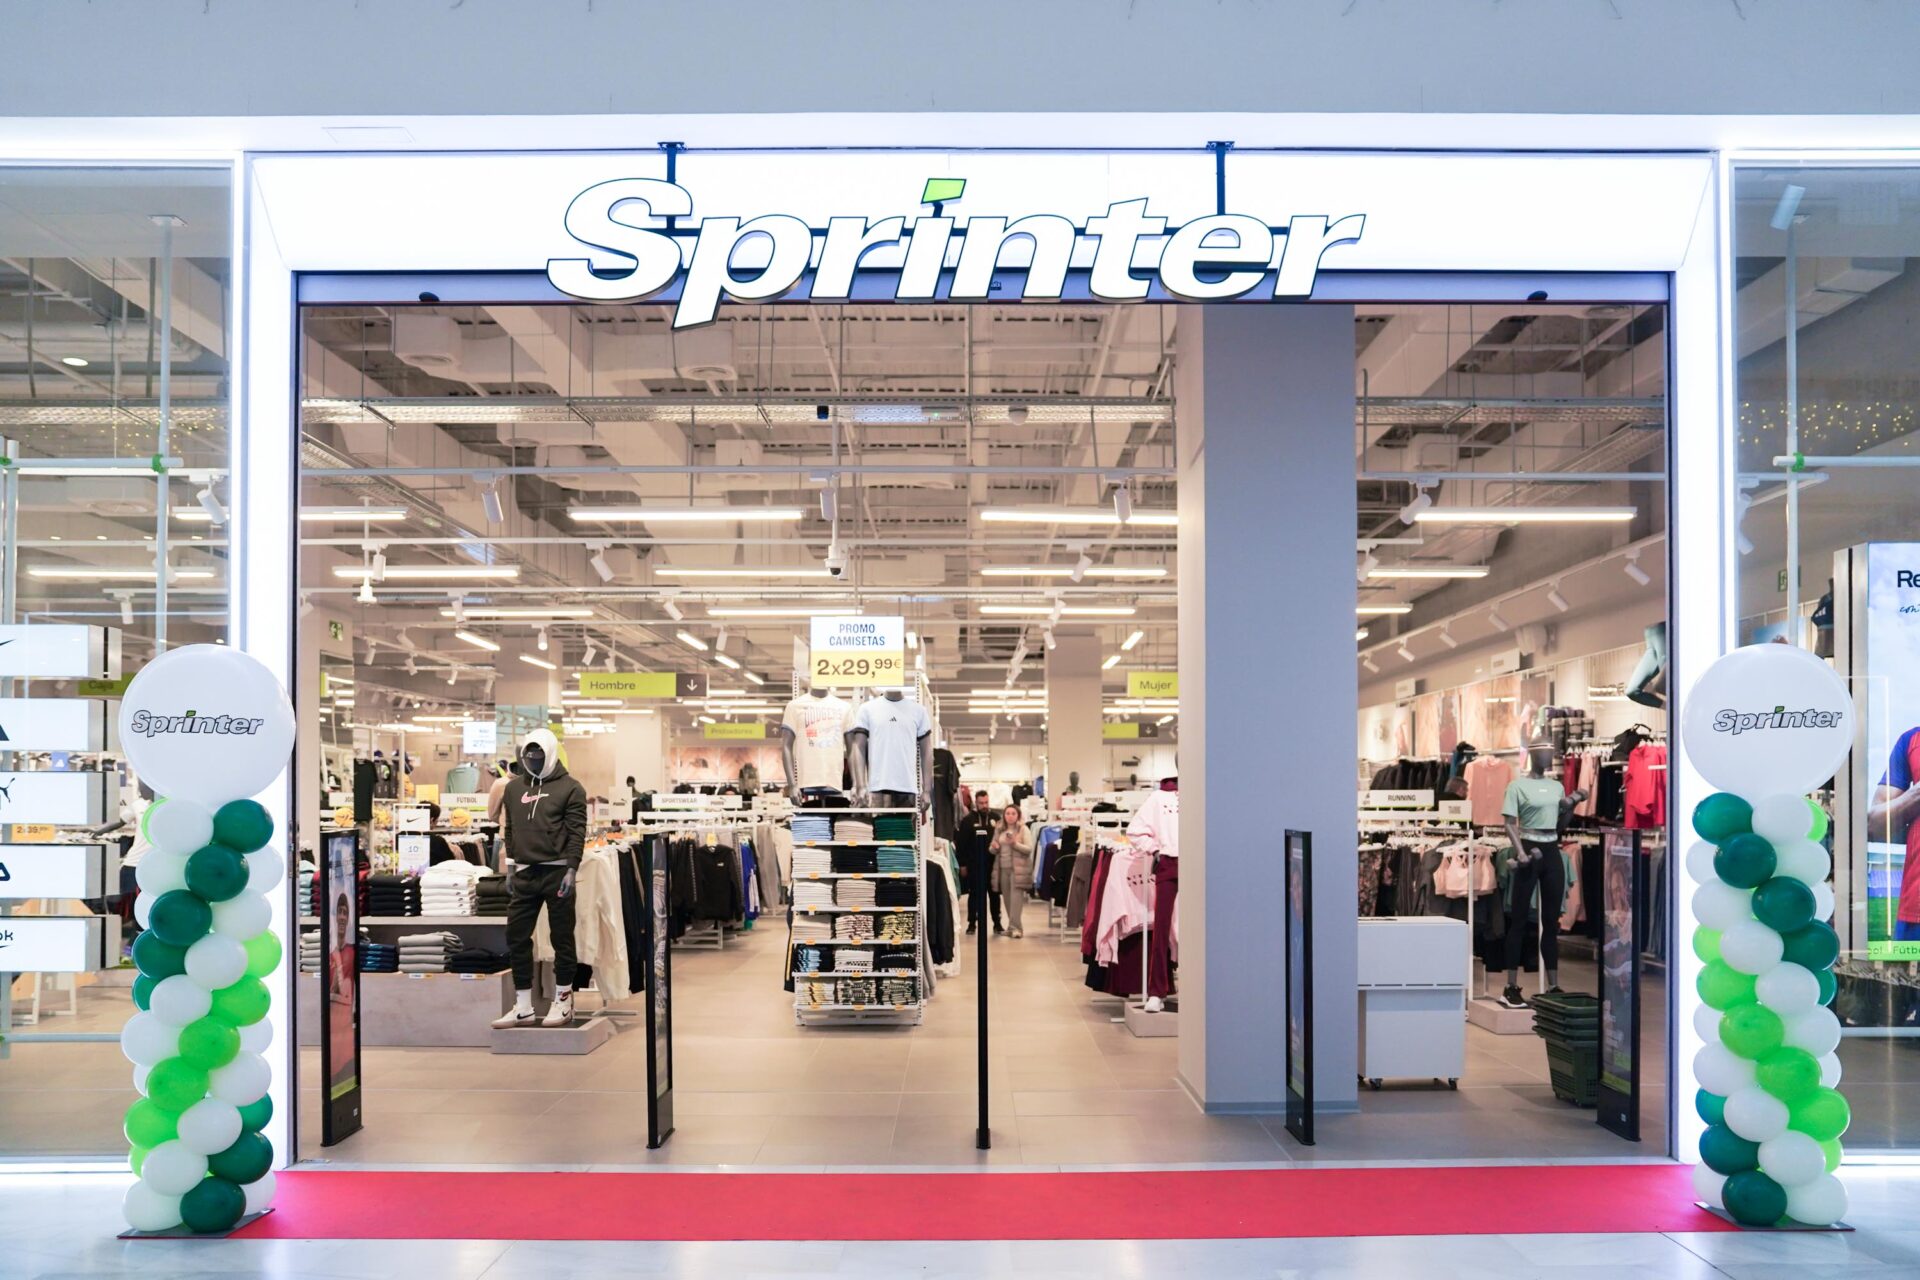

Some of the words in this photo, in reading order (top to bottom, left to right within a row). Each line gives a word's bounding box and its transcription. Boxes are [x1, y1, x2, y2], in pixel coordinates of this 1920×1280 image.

[547, 178, 1365, 330] Sprinter
[839, 623, 875, 633] PROMO
[829, 636, 885, 646] CAMISETAS
[590, 680, 636, 691] Hombre
[1139, 680, 1173, 691] Mujer
[131, 709, 264, 737] Sprinter
[1713, 706, 1842, 735] Sprinter
